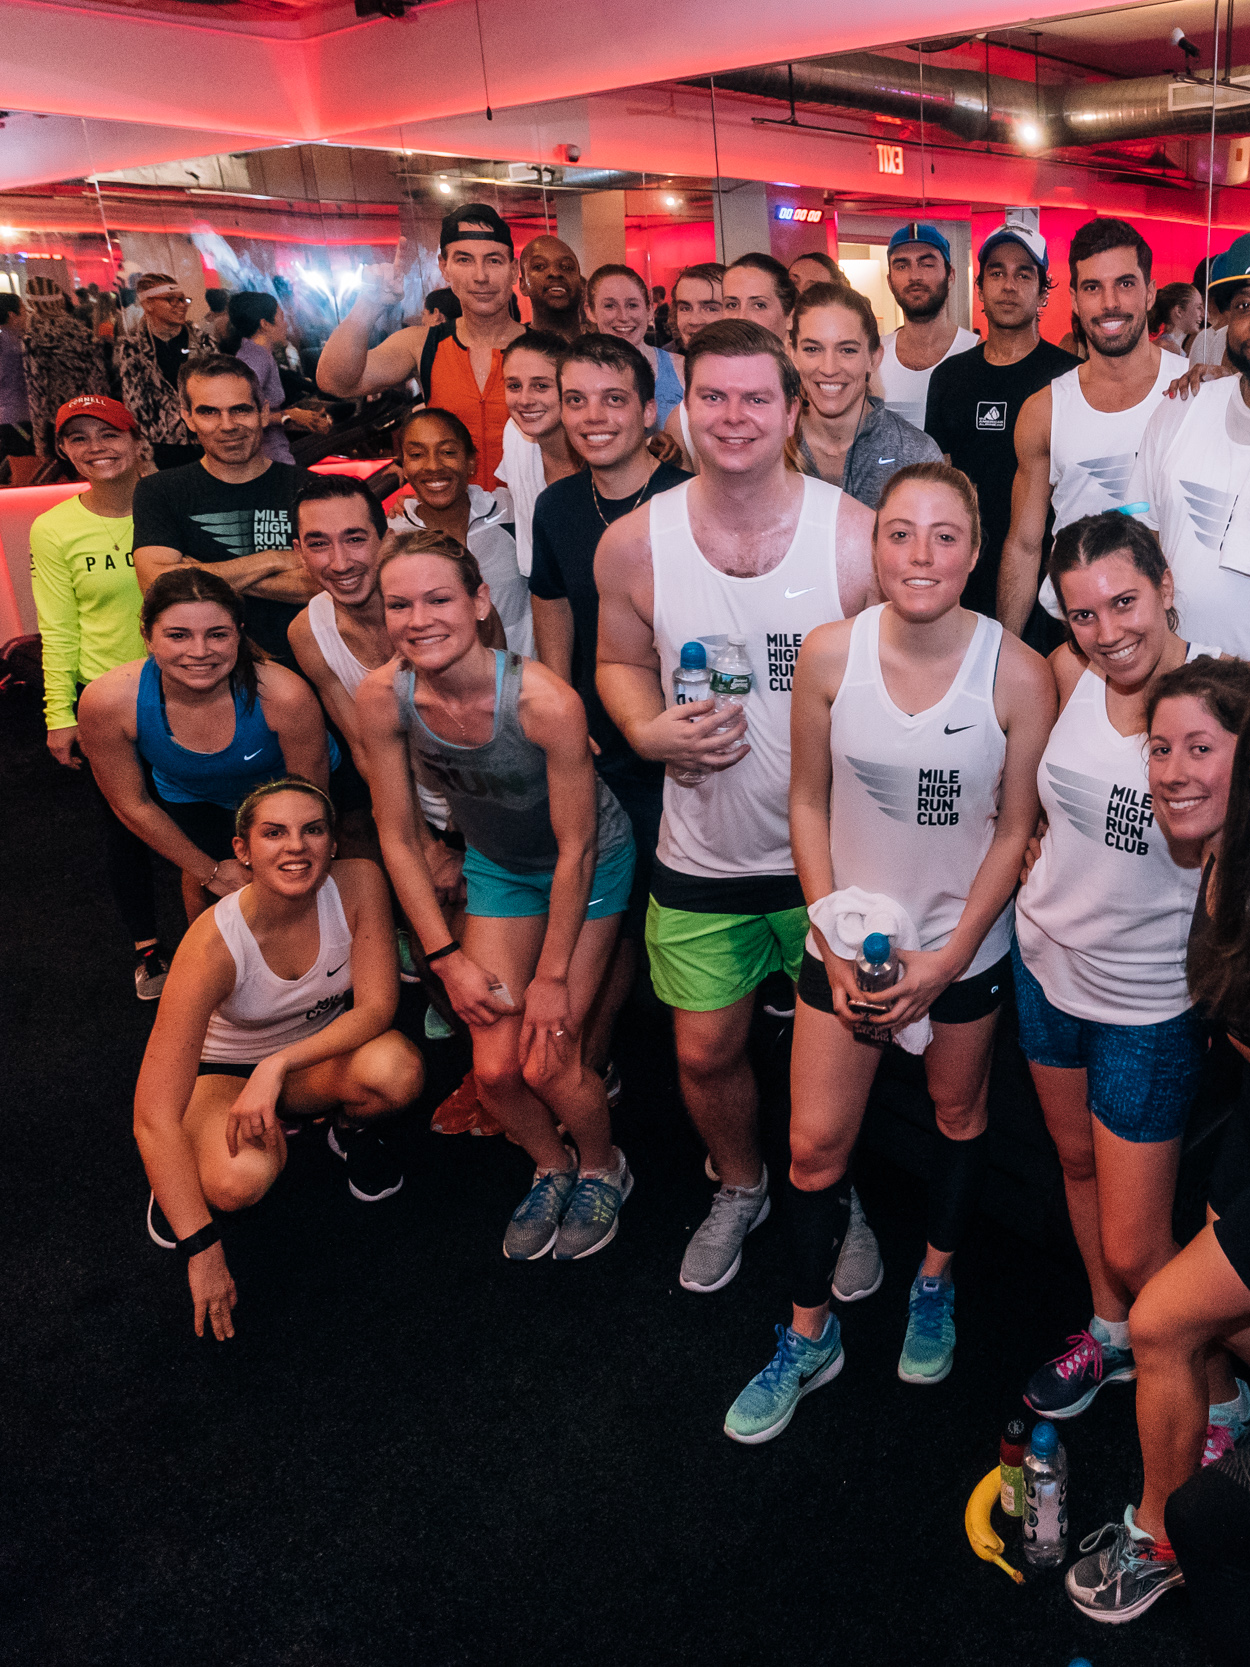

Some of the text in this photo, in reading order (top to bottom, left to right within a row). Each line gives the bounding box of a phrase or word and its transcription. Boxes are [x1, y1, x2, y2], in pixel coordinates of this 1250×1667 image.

[254, 509, 288, 521] MILE
[254, 521, 292, 533] HIGH
[254, 533, 287, 545] RUN
[766, 633, 802, 648] MILE
[918, 767, 960, 784] MILE
[917, 783, 962, 798] HIGH
[1110, 783, 1154, 810] MILE
[917, 797, 954, 812] RUN
[916, 812, 960, 826] CLUB
[1106, 800, 1155, 828] HIGH
[1105, 815, 1144, 840] RUN
[1104, 831, 1149, 856] CLUB
